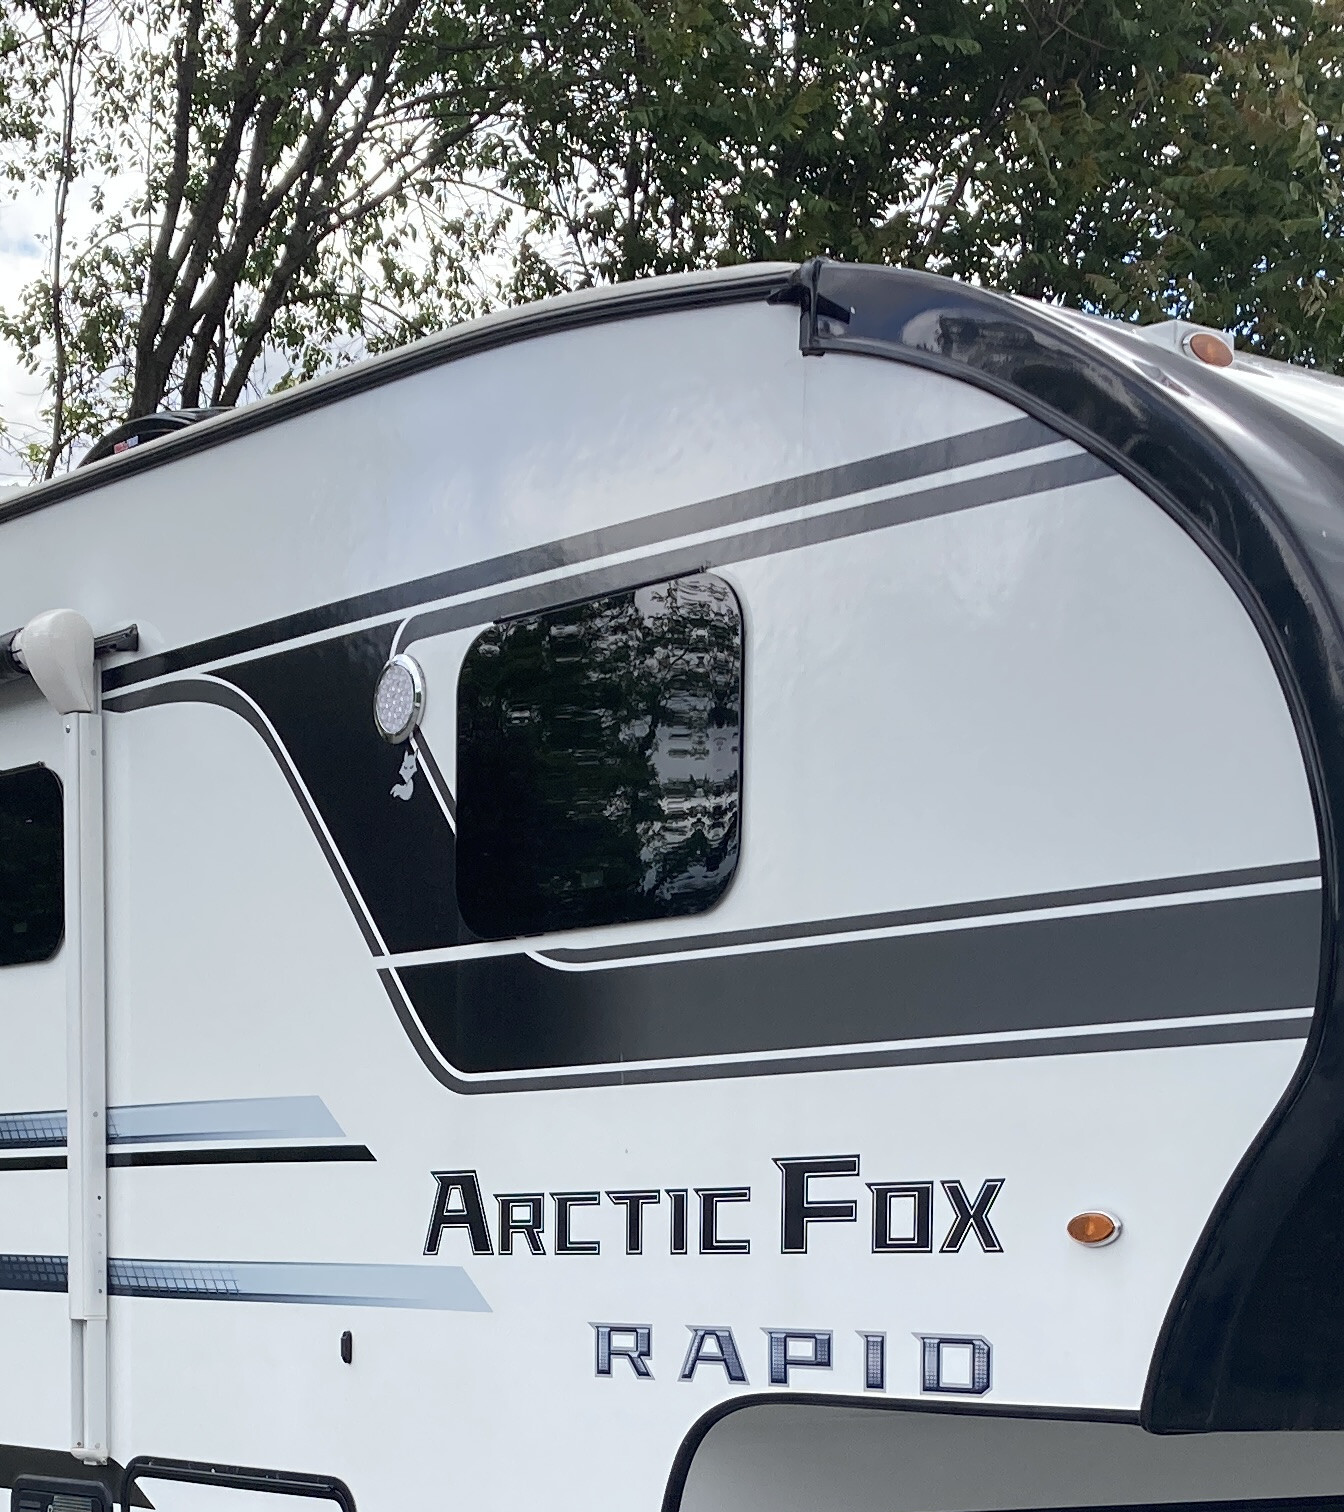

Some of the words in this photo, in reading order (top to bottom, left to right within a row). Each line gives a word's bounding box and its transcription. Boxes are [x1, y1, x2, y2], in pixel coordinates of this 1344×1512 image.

[422, 1169, 752, 1257] ARCTIC
[772, 1153, 1007, 1255] FOX
[587, 1320, 996, 1399] RAPID
